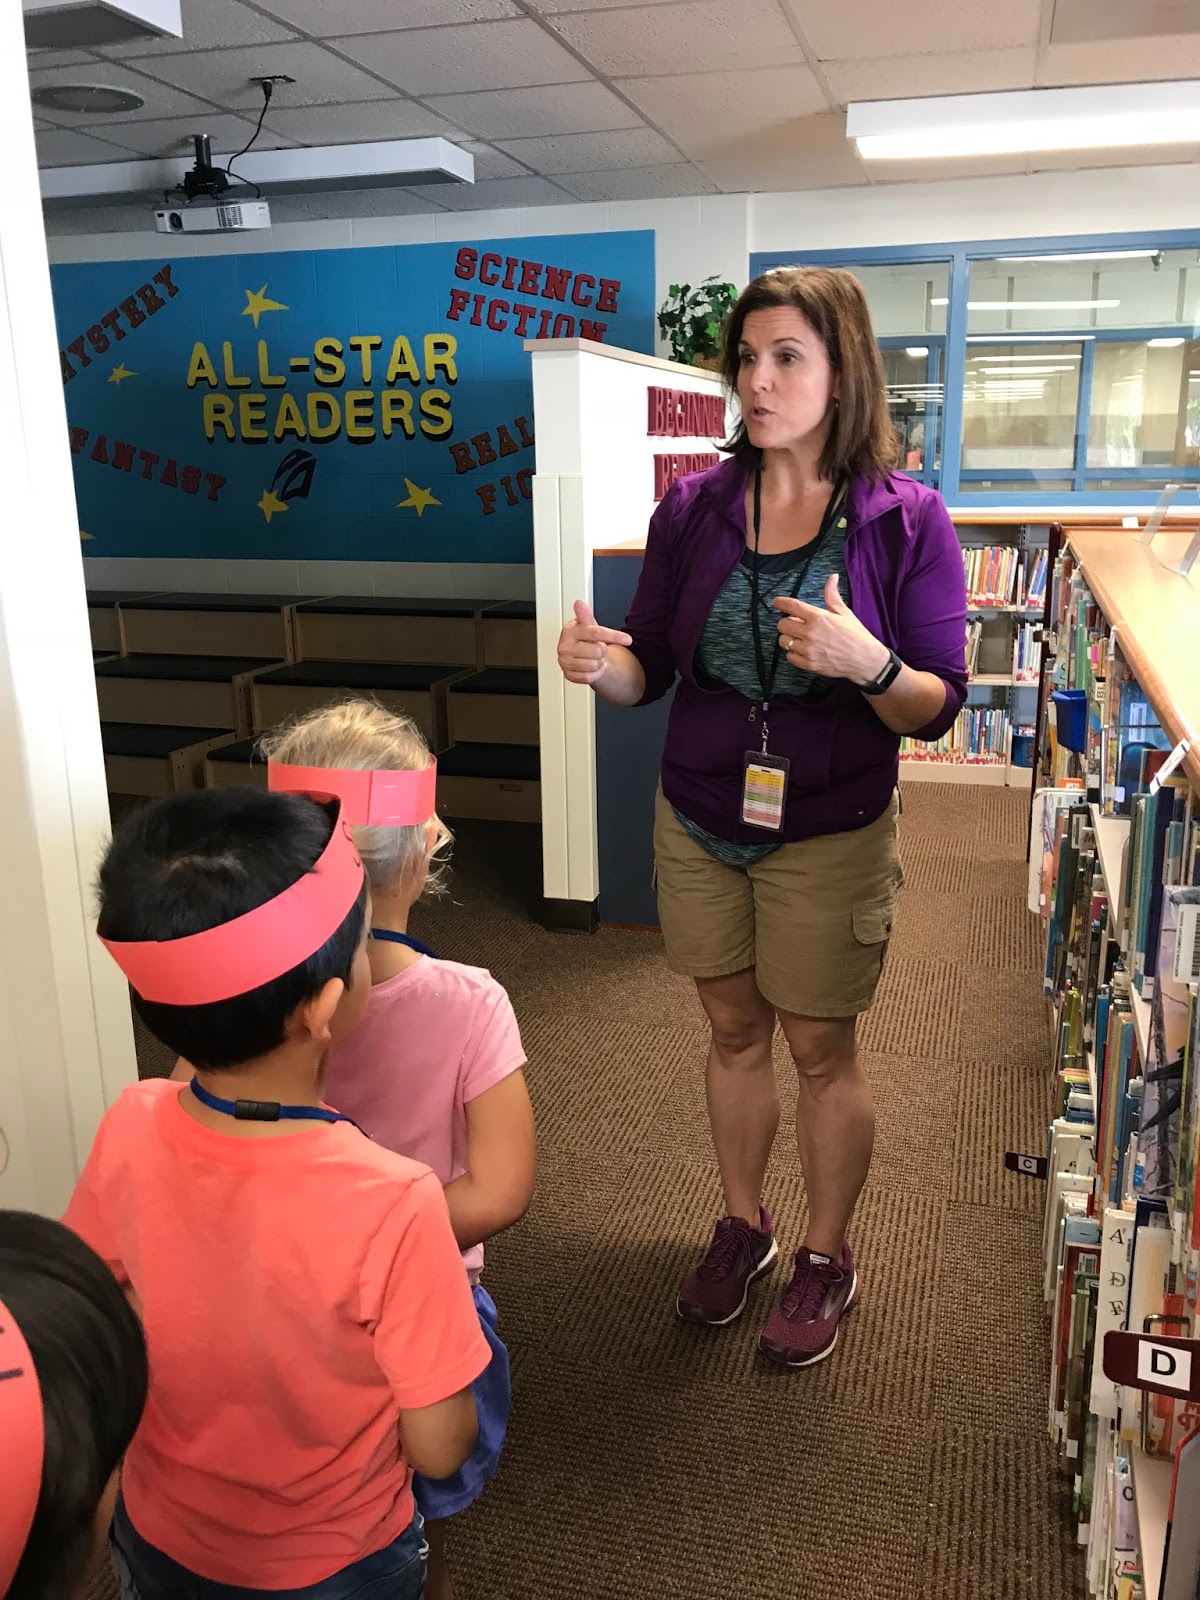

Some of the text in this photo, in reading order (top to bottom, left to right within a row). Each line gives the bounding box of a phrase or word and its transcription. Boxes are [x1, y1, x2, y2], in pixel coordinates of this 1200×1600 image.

[455, 247, 621, 313] SCIENCE
[187, 333, 458, 388] ALL-STAR
[203, 389, 454, 444] READERS
[449, 413, 535, 474] REAL
[70, 426, 226, 501] FANTASY
[1023, 1159, 1033, 1169] C
[1151, 1348, 1176, 1375] D
